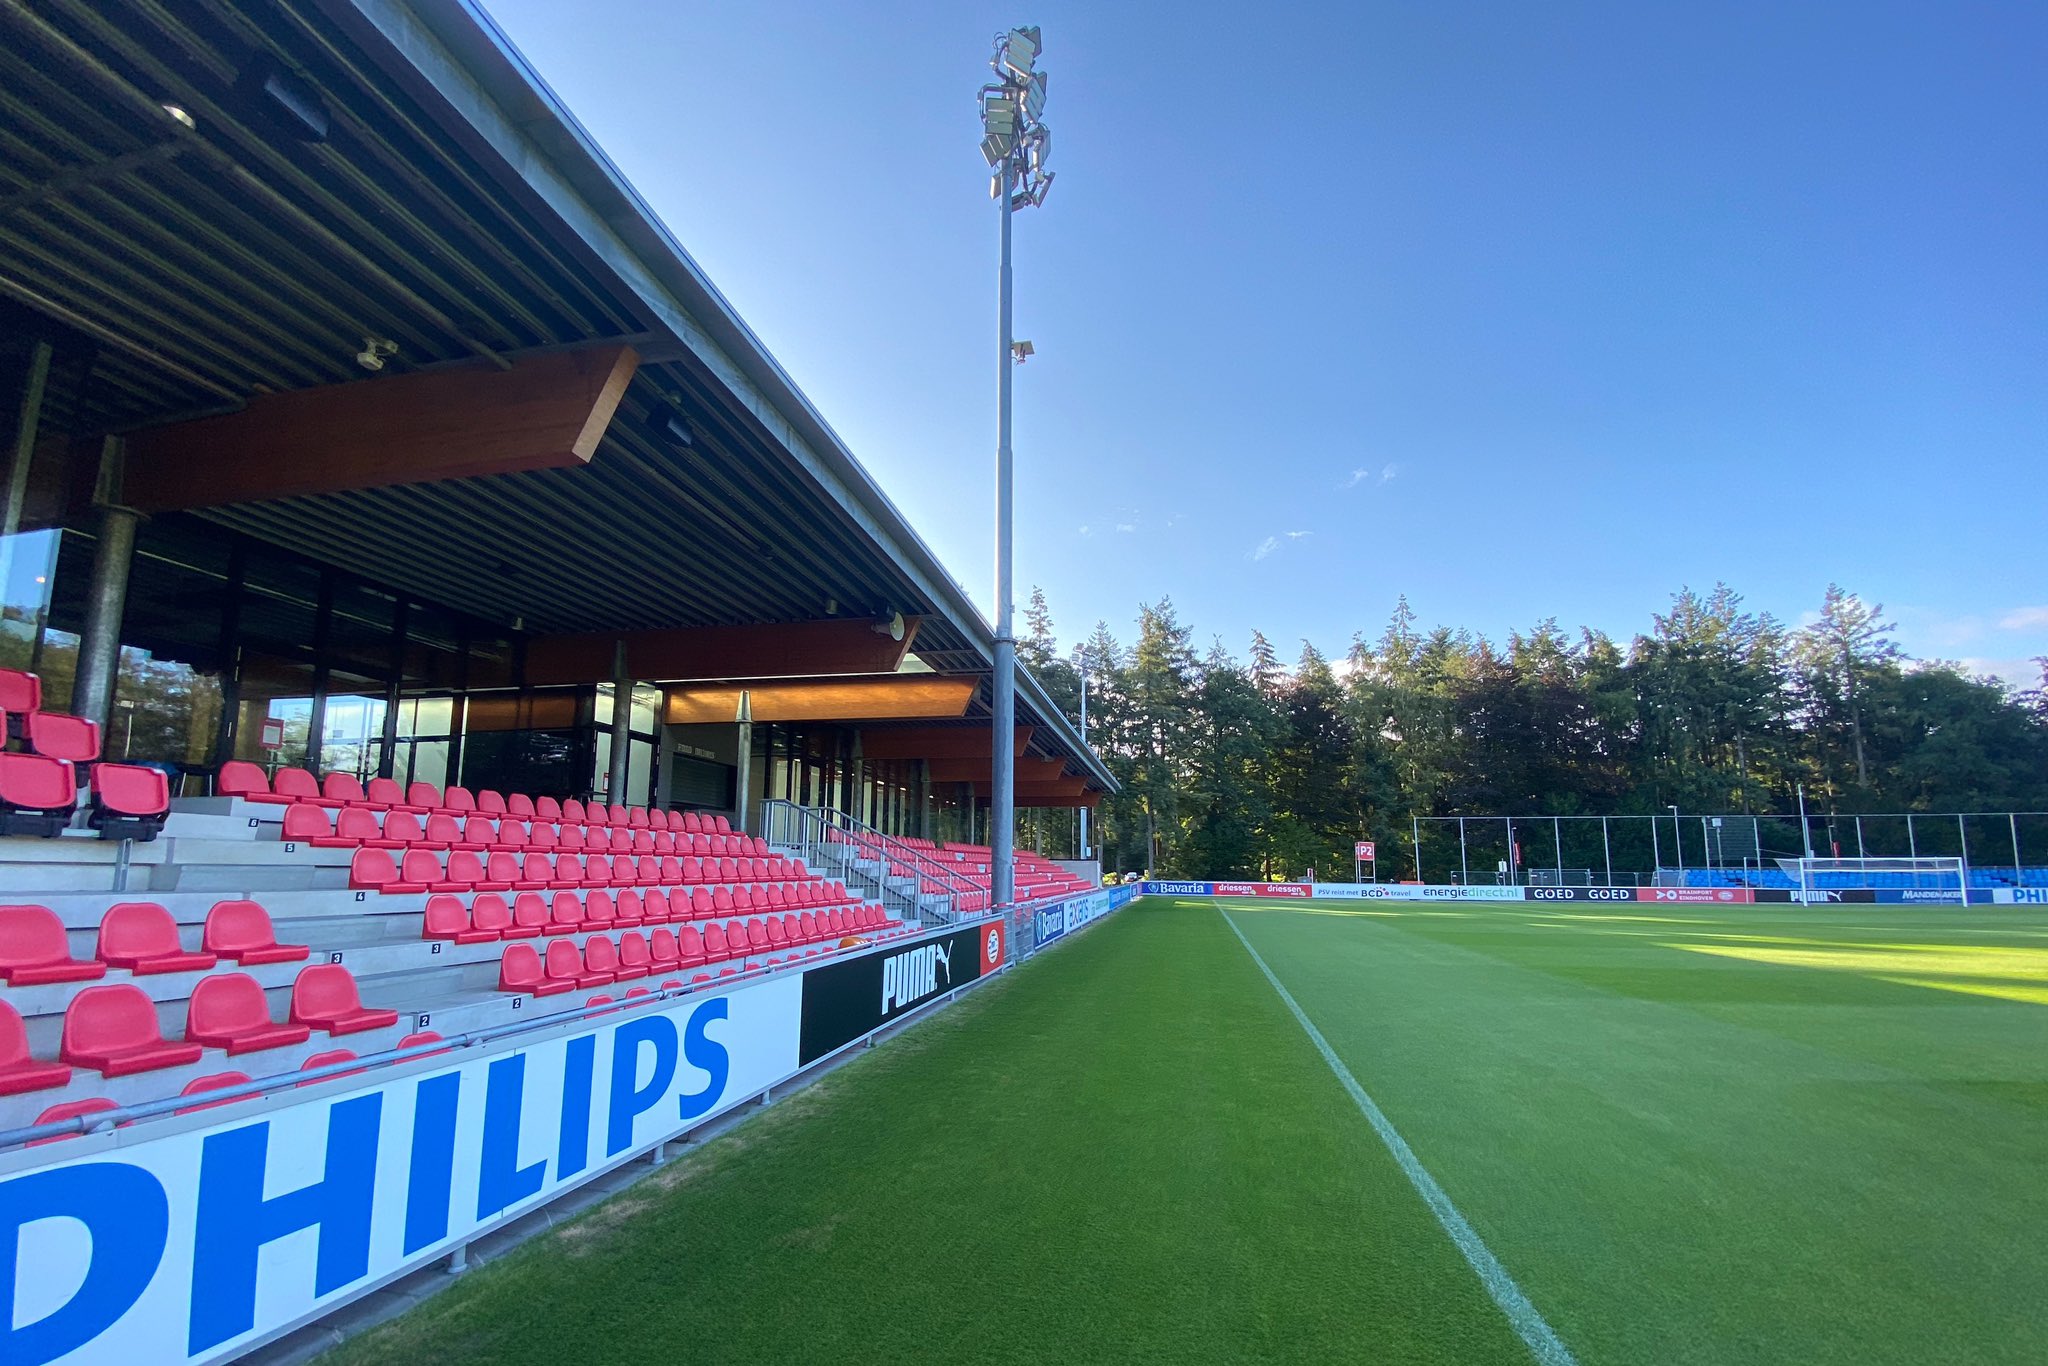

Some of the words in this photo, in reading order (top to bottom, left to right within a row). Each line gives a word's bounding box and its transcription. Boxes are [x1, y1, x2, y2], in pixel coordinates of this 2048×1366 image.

[1360, 846, 1373, 856] P2
[1160, 882, 1205, 893] Bavaria
[1361, 889, 1383, 897] BCD
[1423, 887, 1518, 898] energiedirect.nl
[1534, 889, 1574, 899] GOED
[1588, 889, 1629, 899] GOED
[1042, 905, 1063, 940] Bavaria
[881, 944, 937, 1015] PUMA
[0, 997, 729, 1366] PHILIPS
